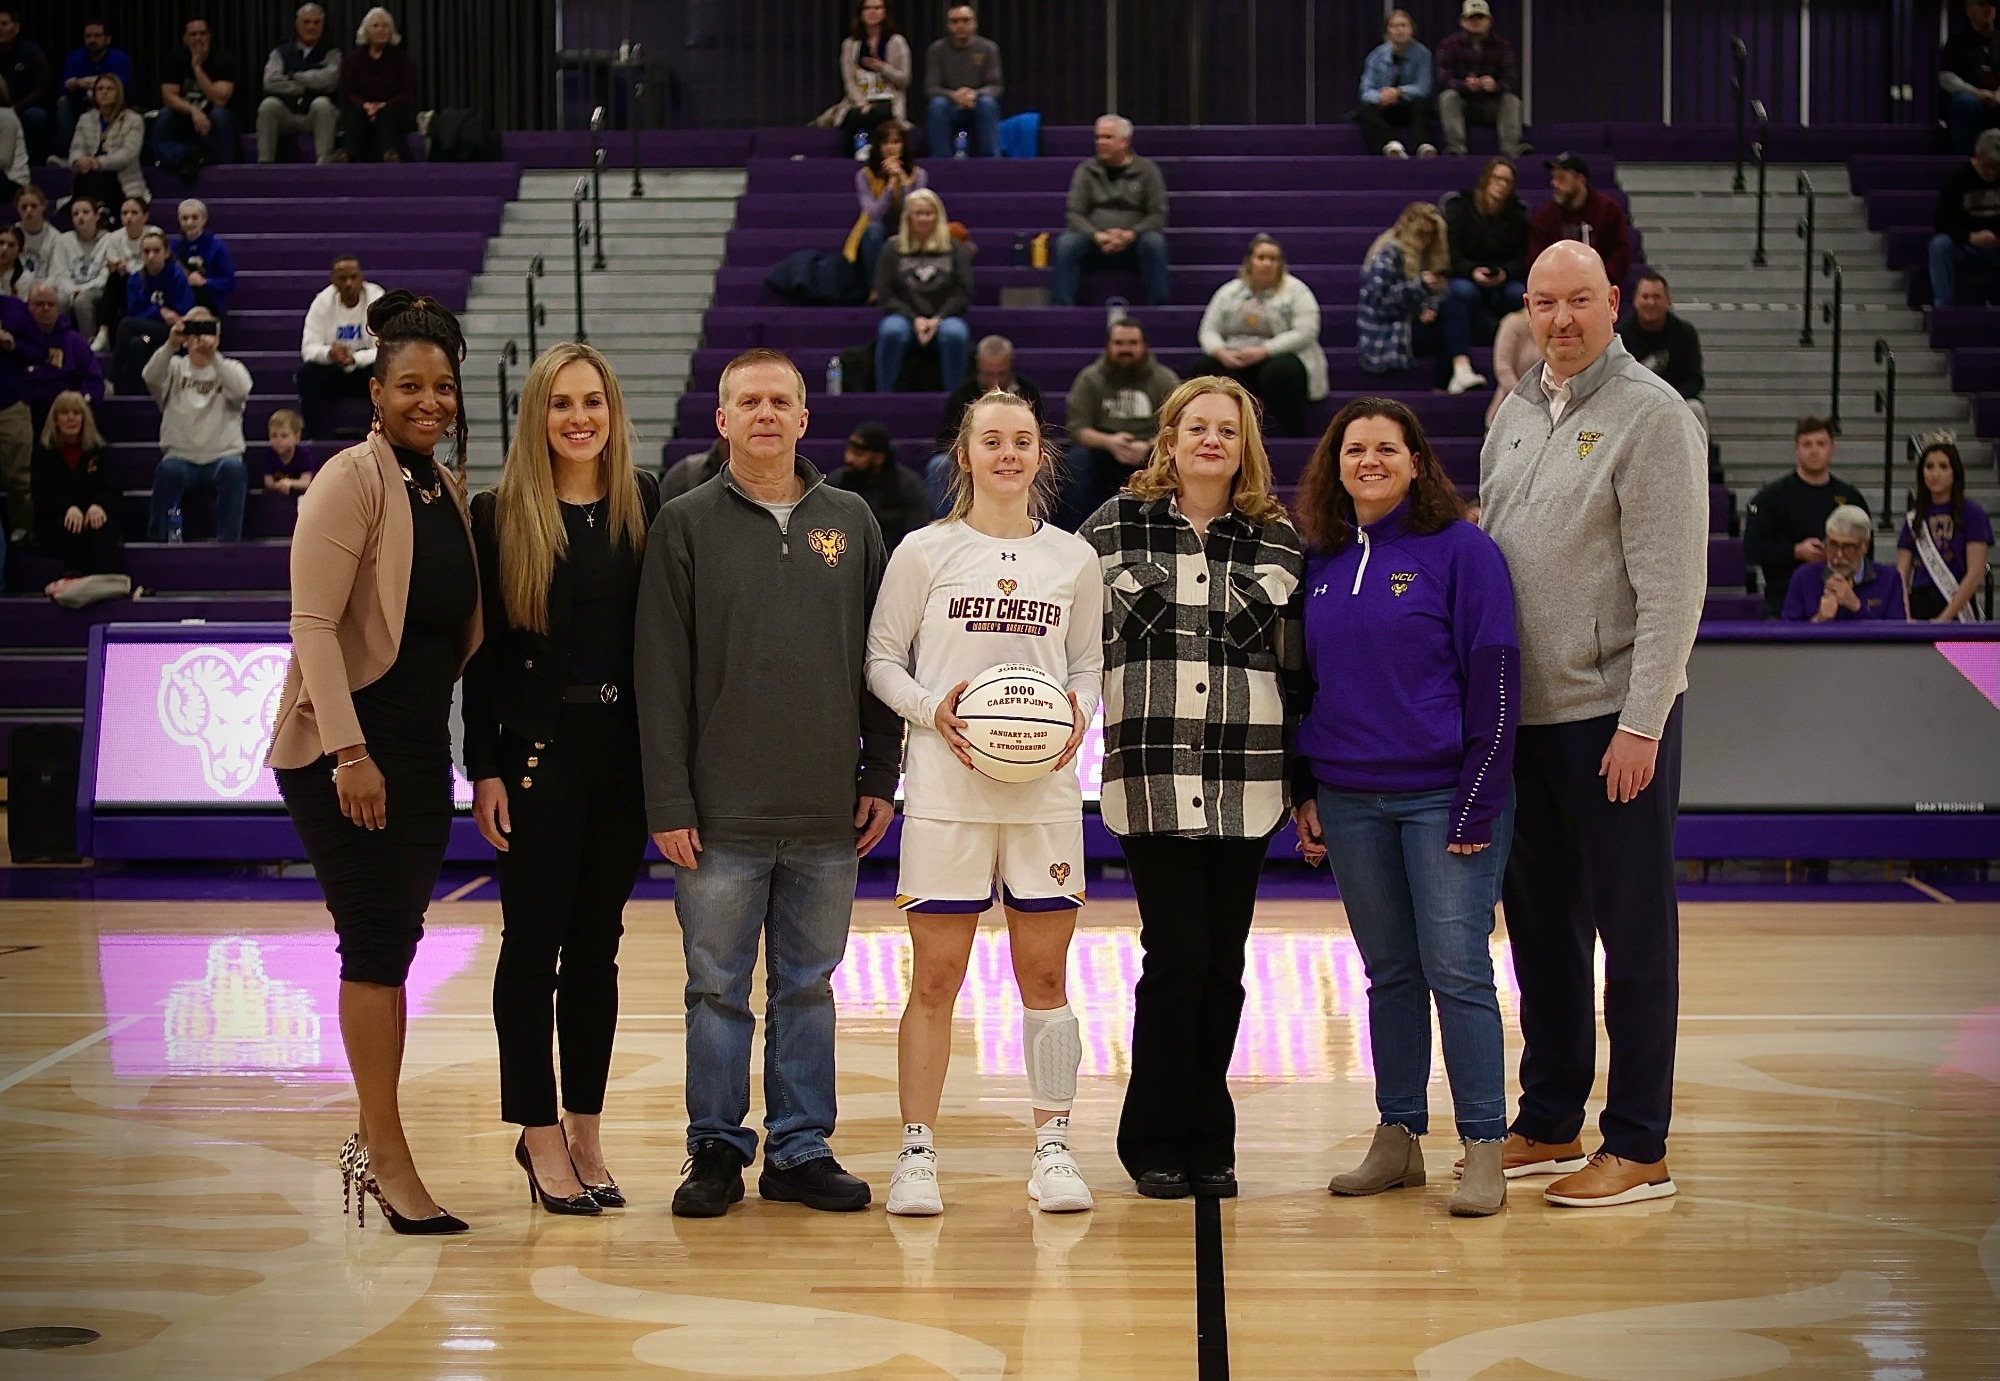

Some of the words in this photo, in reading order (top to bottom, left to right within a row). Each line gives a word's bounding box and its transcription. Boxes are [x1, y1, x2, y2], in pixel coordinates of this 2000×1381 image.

[1390, 572, 1418, 582] WCU
[948, 597, 995, 619] WEST
[996, 598, 1061, 627] CHESTER
[972, 622, 1001, 631] WOMEN'S
[1006, 624, 1041, 635] BASKETBALL
[997, 666, 1045, 677] JOHNSON
[1003, 685, 1035, 696] 1000
[989, 729, 1022, 738] JANUARY
[996, 743, 1047, 751] STROUDSBURG
[1914, 801, 1985, 812] DAKTRONICS
